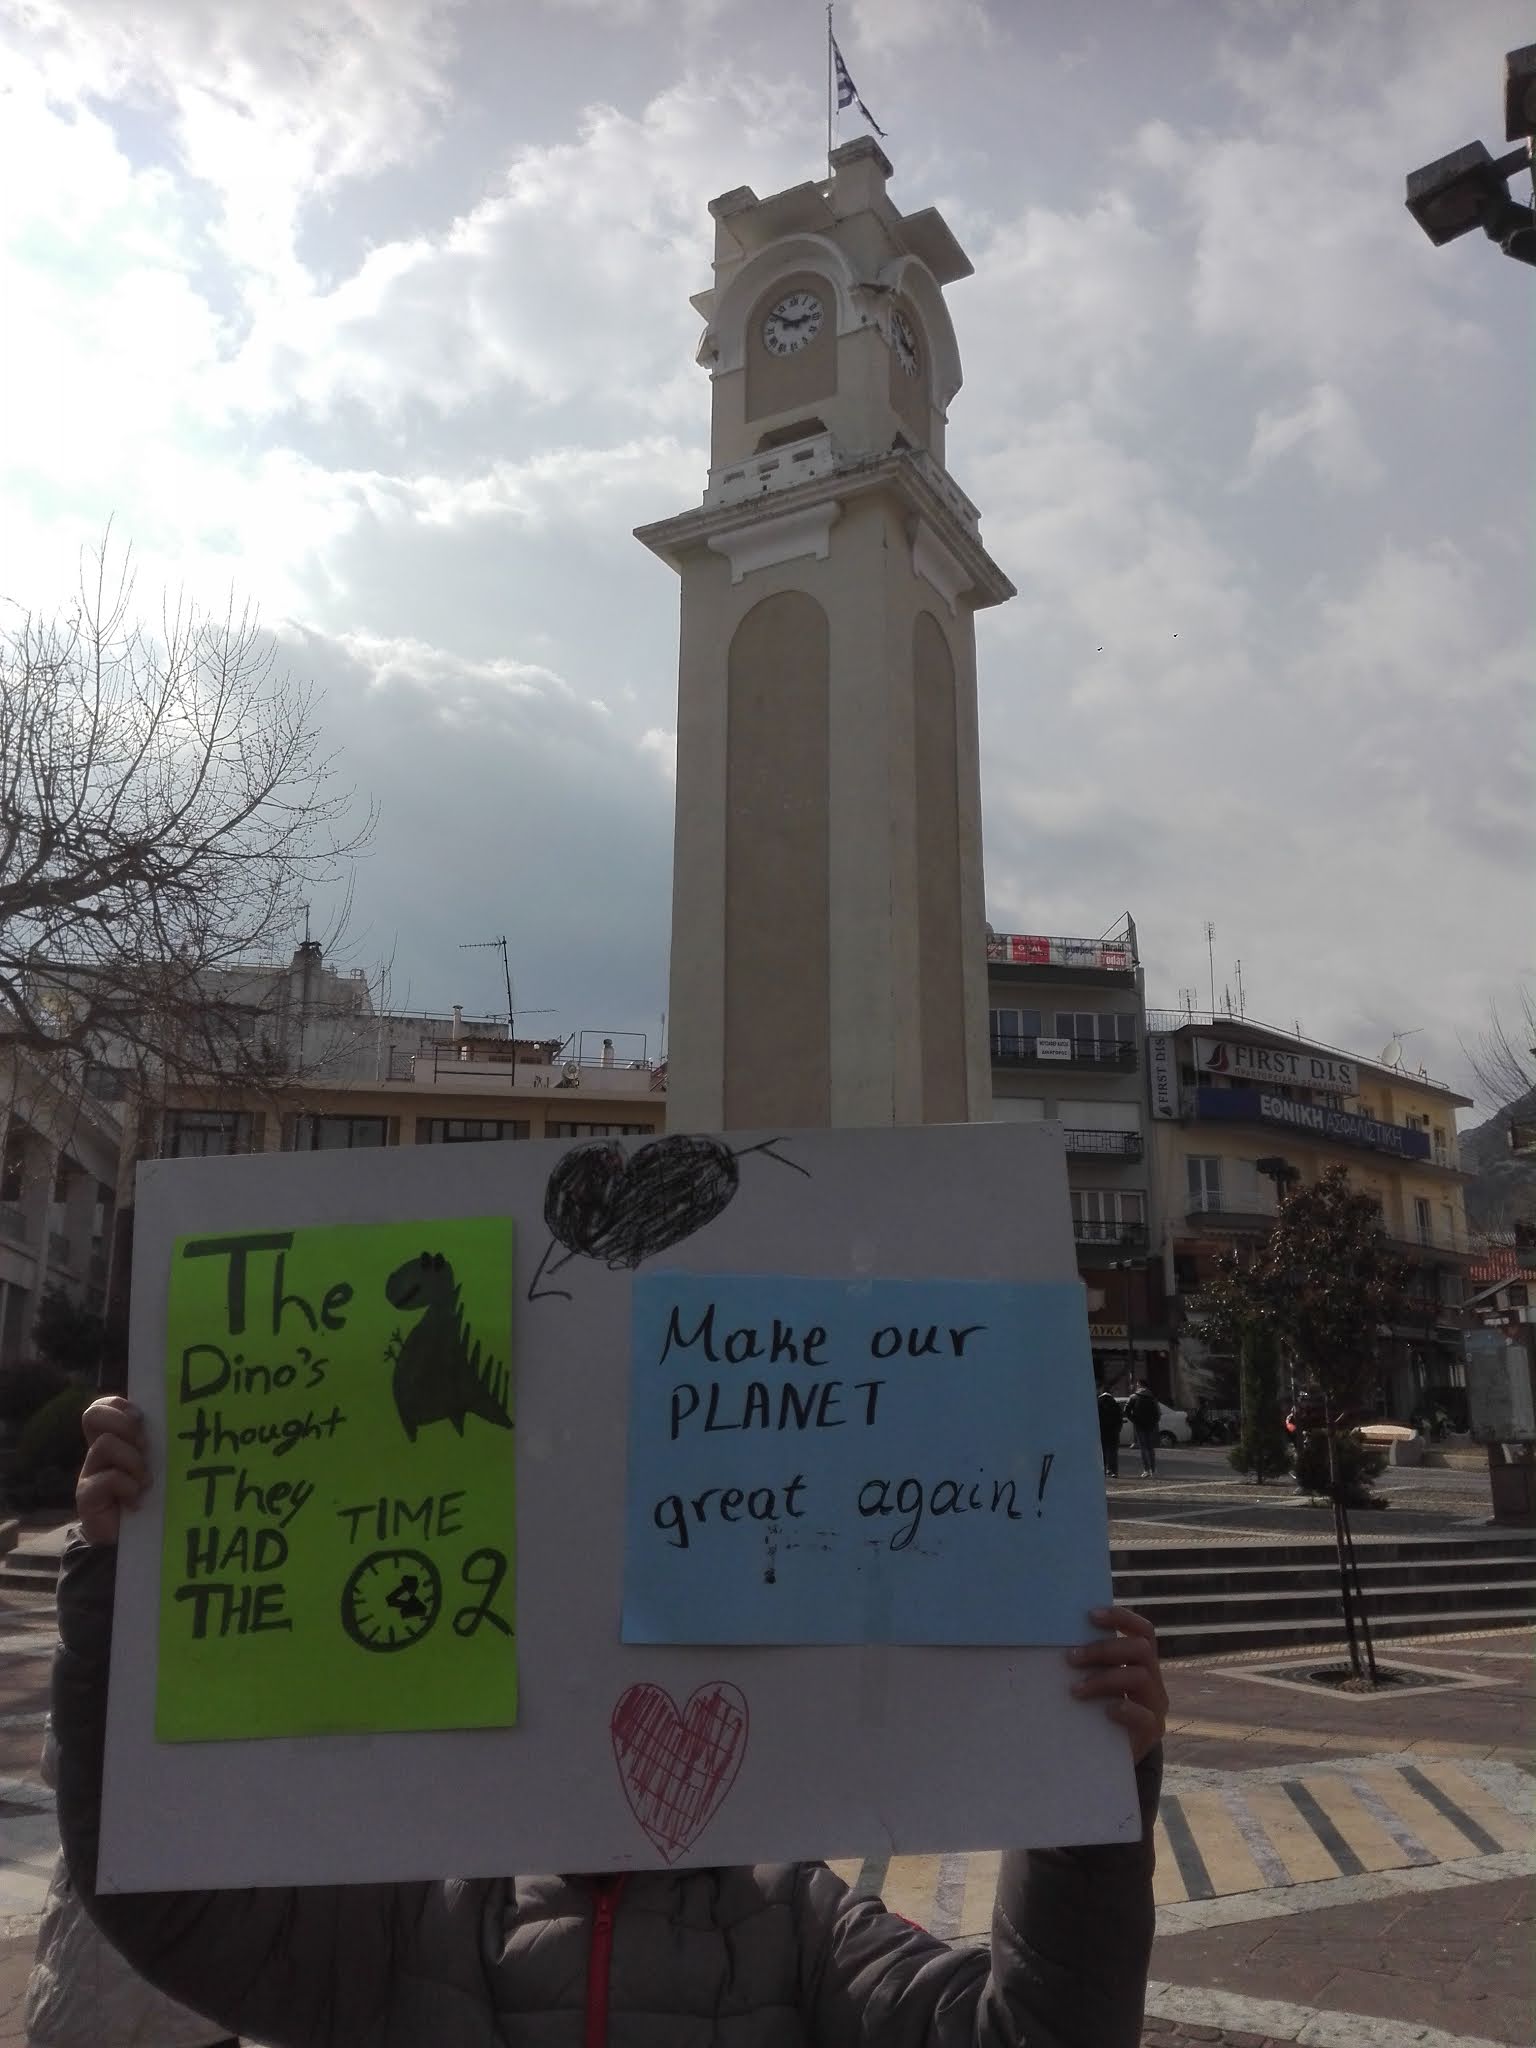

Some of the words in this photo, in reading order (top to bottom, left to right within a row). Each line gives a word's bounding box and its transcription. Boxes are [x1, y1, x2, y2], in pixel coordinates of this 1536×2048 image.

[1156, 1067, 1169, 1104] FIRST
[1235, 1046, 1300, 1076] FIRST
[1260, 1095, 1324, 1129] ΕΘΝΙΚΗ
[1326, 1115, 1402, 1147] ΑΣΦΑΛΙΣΤΙΚΗ
[182, 1231, 354, 1336] The
[659, 1303, 829, 1366] Make
[870, 1322, 989, 1360] our
[179, 1344, 329, 1405] Dino's
[177, 1408, 347, 1459] thought
[670, 1380, 886, 1440] PLANET
[186, 1465, 315, 1527] They
[336, 1490, 467, 1544] TIME
[653, 1475, 807, 1549] great
[858, 1454, 1055, 1551] again!
[186, 1526, 289, 1578] HAD
[174, 1583, 293, 1638] THE
